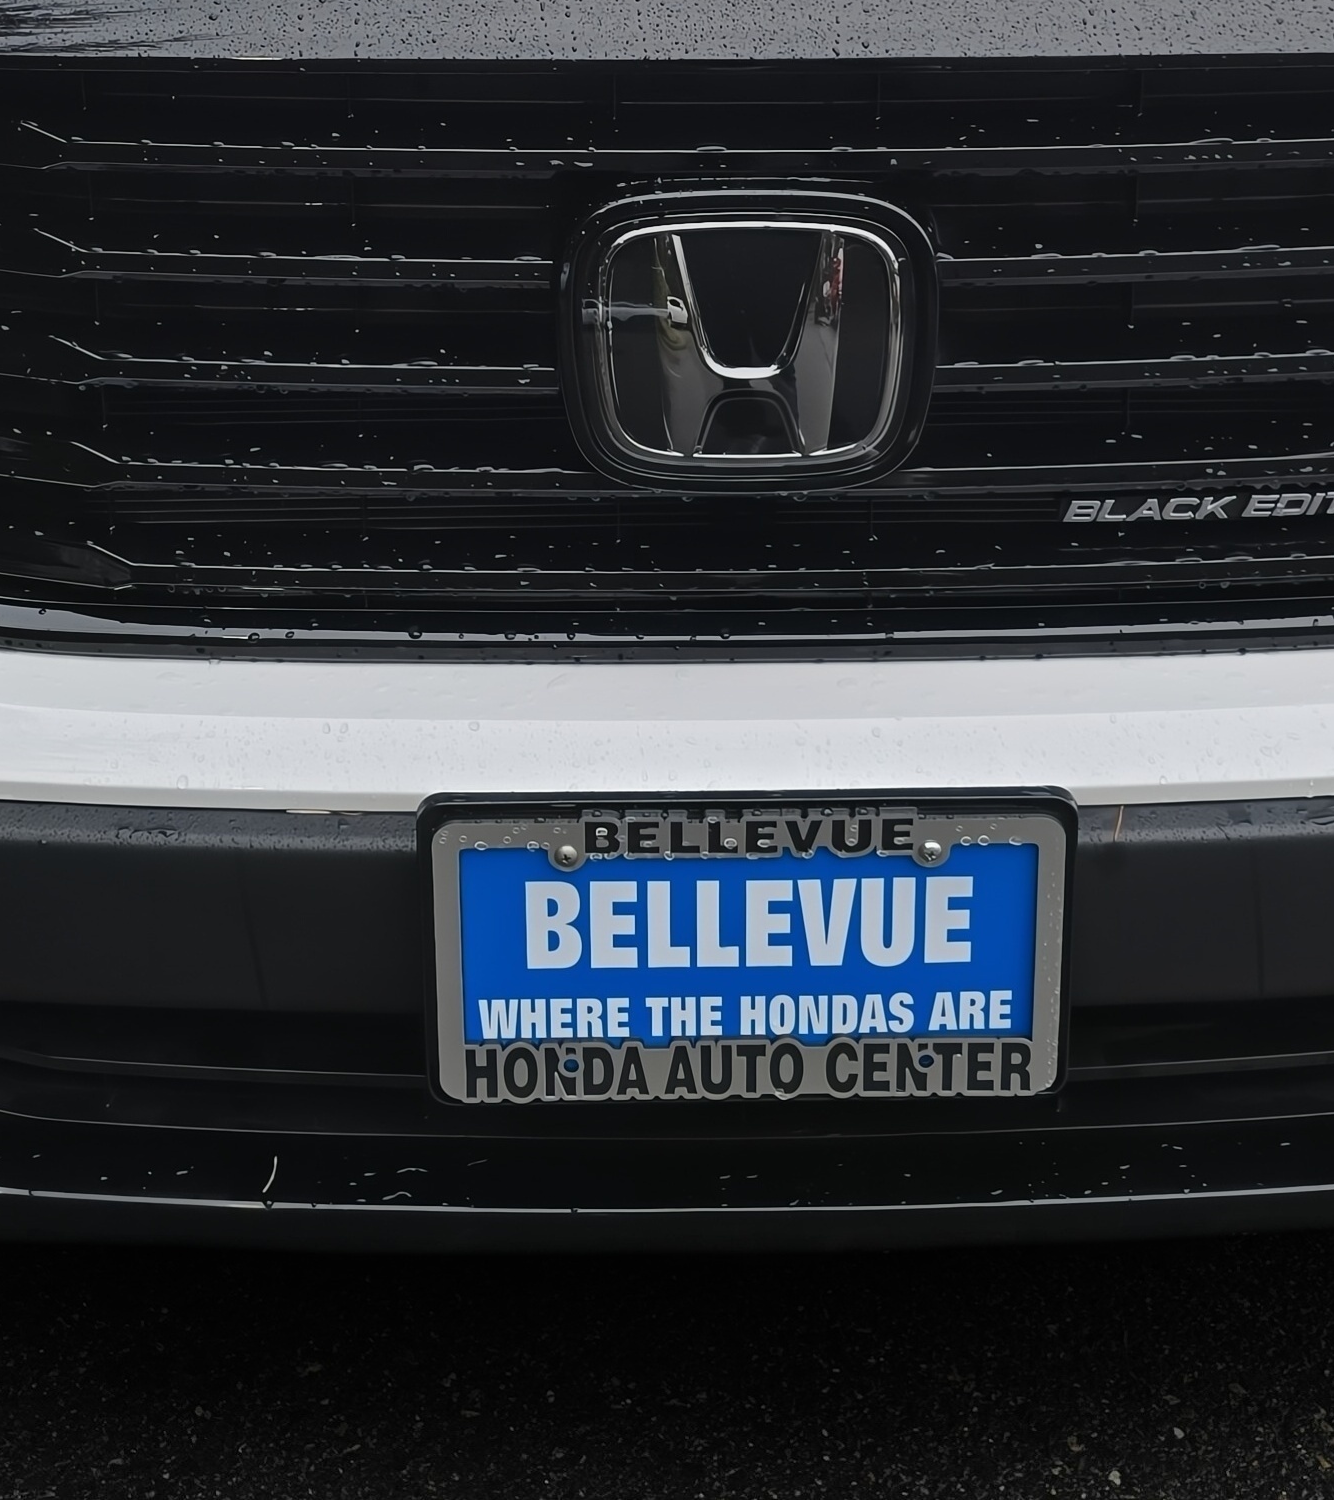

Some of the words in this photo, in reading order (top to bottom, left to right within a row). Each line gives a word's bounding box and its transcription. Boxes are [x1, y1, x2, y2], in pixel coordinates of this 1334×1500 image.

[1063, 496, 1237, 523] BLACK
[583, 817, 915, 855] BELLEVUE
[524, 876, 975, 970] BELLEVUE
[478, 997, 630, 1040] WHERE
[645, 996, 724, 1037] THE
[739, 991, 915, 1036] HONDAS
[928, 989, 1014, 1032] ARE
[465, 1046, 642, 1098] HONDA
[666, 1043, 805, 1095] AUTO
[825, 1042, 1033, 1094] CENTER
